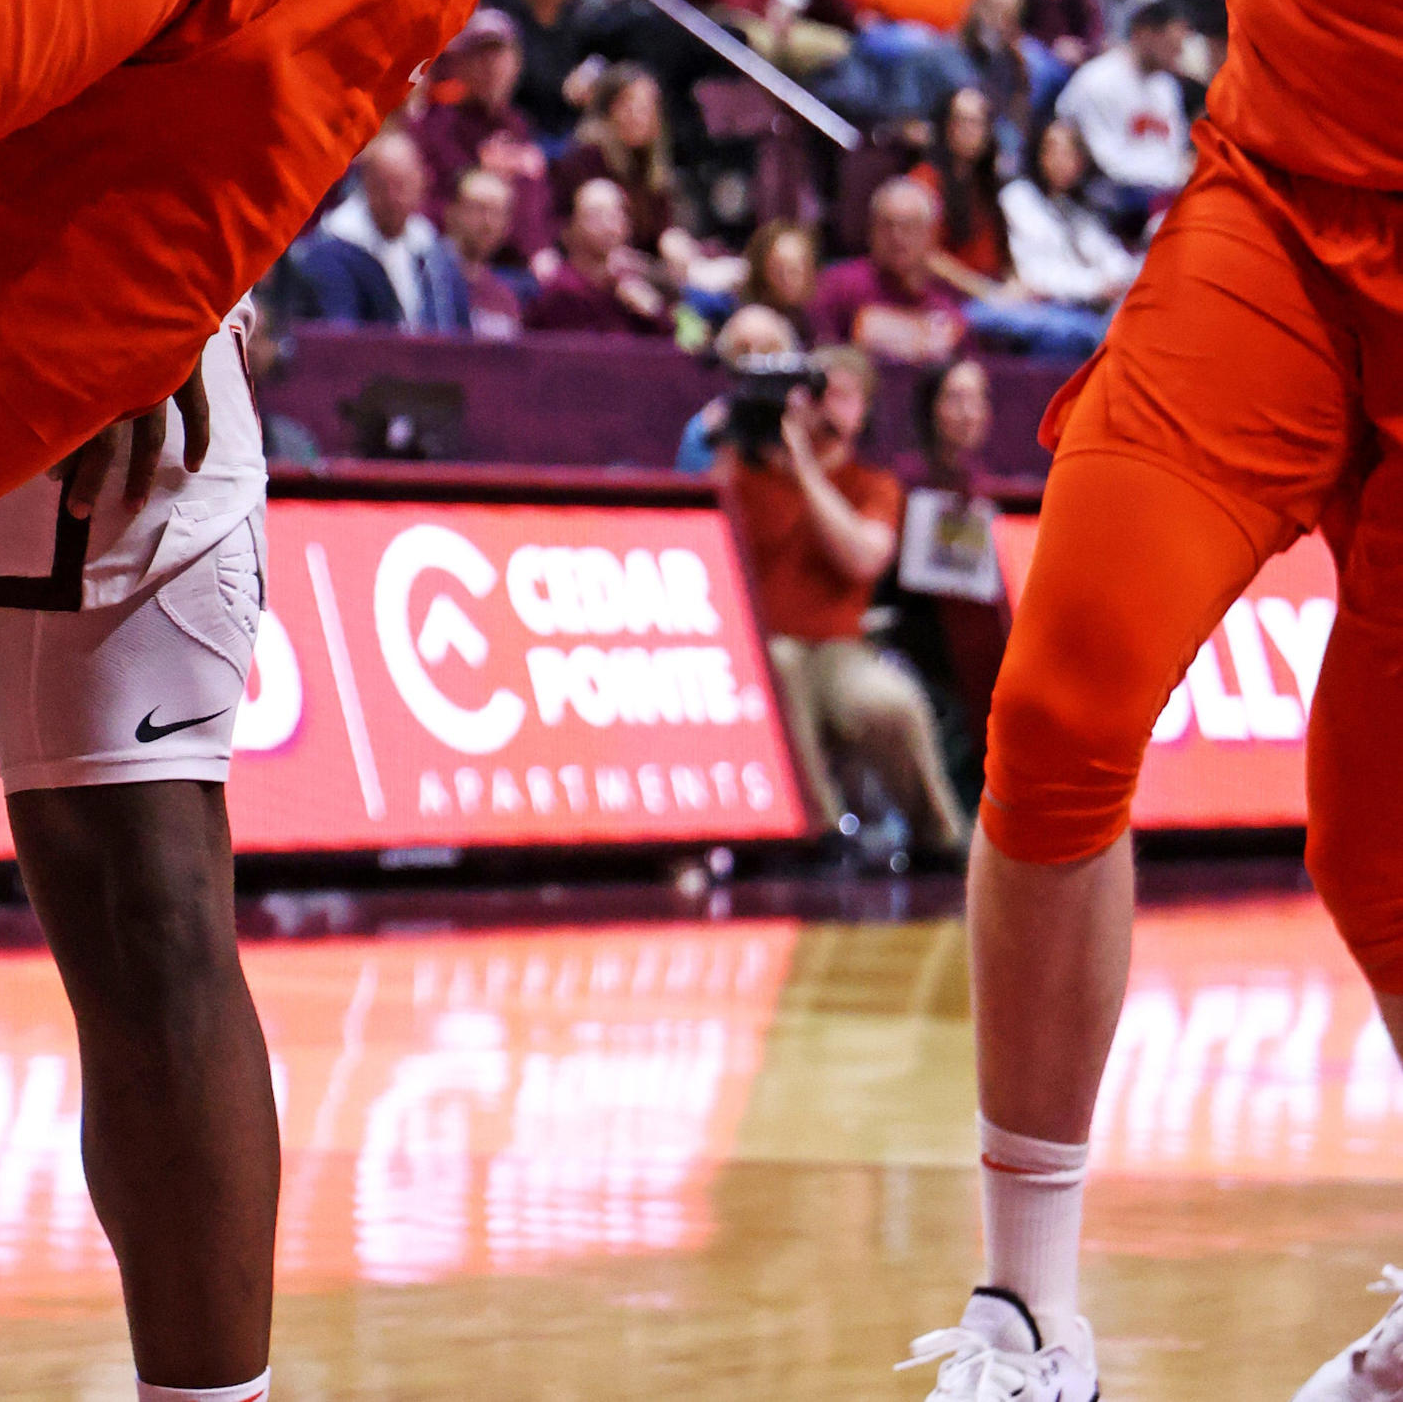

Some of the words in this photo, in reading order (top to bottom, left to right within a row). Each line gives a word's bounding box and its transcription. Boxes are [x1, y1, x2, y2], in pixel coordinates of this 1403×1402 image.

[506, 544, 721, 636] CEDAR
[526, 645, 740, 726] POINTE
[418, 760, 774, 816] APARTMENTS
